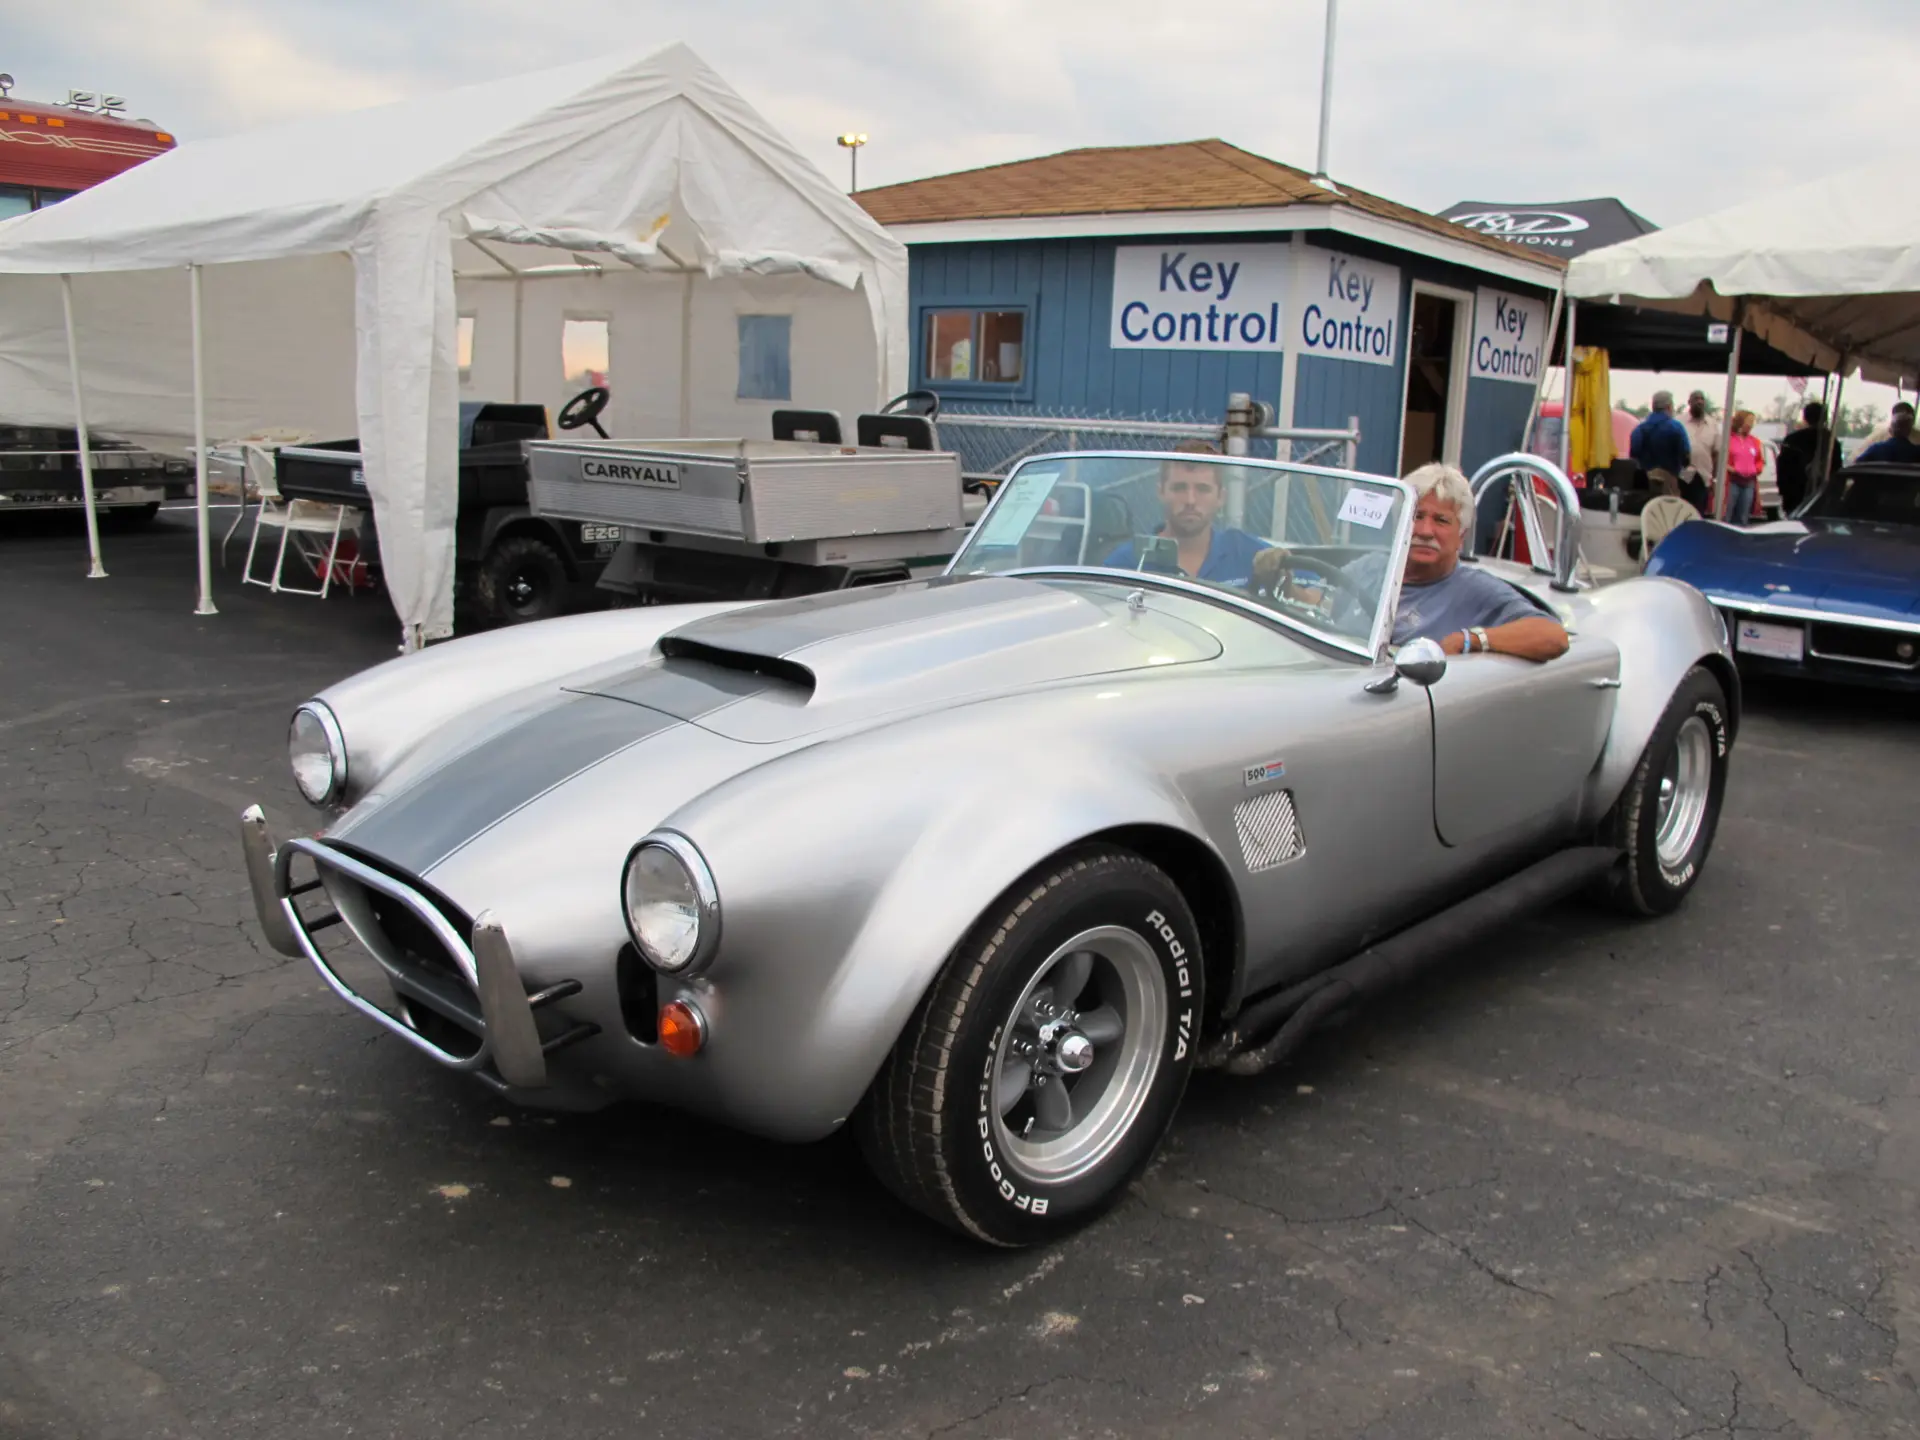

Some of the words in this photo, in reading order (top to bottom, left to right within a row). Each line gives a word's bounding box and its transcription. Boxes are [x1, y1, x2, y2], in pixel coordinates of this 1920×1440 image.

[1497, 234, 1575, 248] TIONS
[1159, 252, 1241, 301] Key
[1328, 255, 1375, 313] Key
[1120, 301, 1279, 344] Control
[1302, 303, 1393, 358] Control
[1496, 295, 1529, 342] Key
[1477, 335, 1540, 379] Control
[583, 461, 678, 484] CARRYALL
[1247, 766, 1266, 781] 500
[1145, 909, 1193, 998] Radial
[1173, 1007, 1193, 1062] T/A
[977, 1025, 1050, 1215] BFGoodrich
